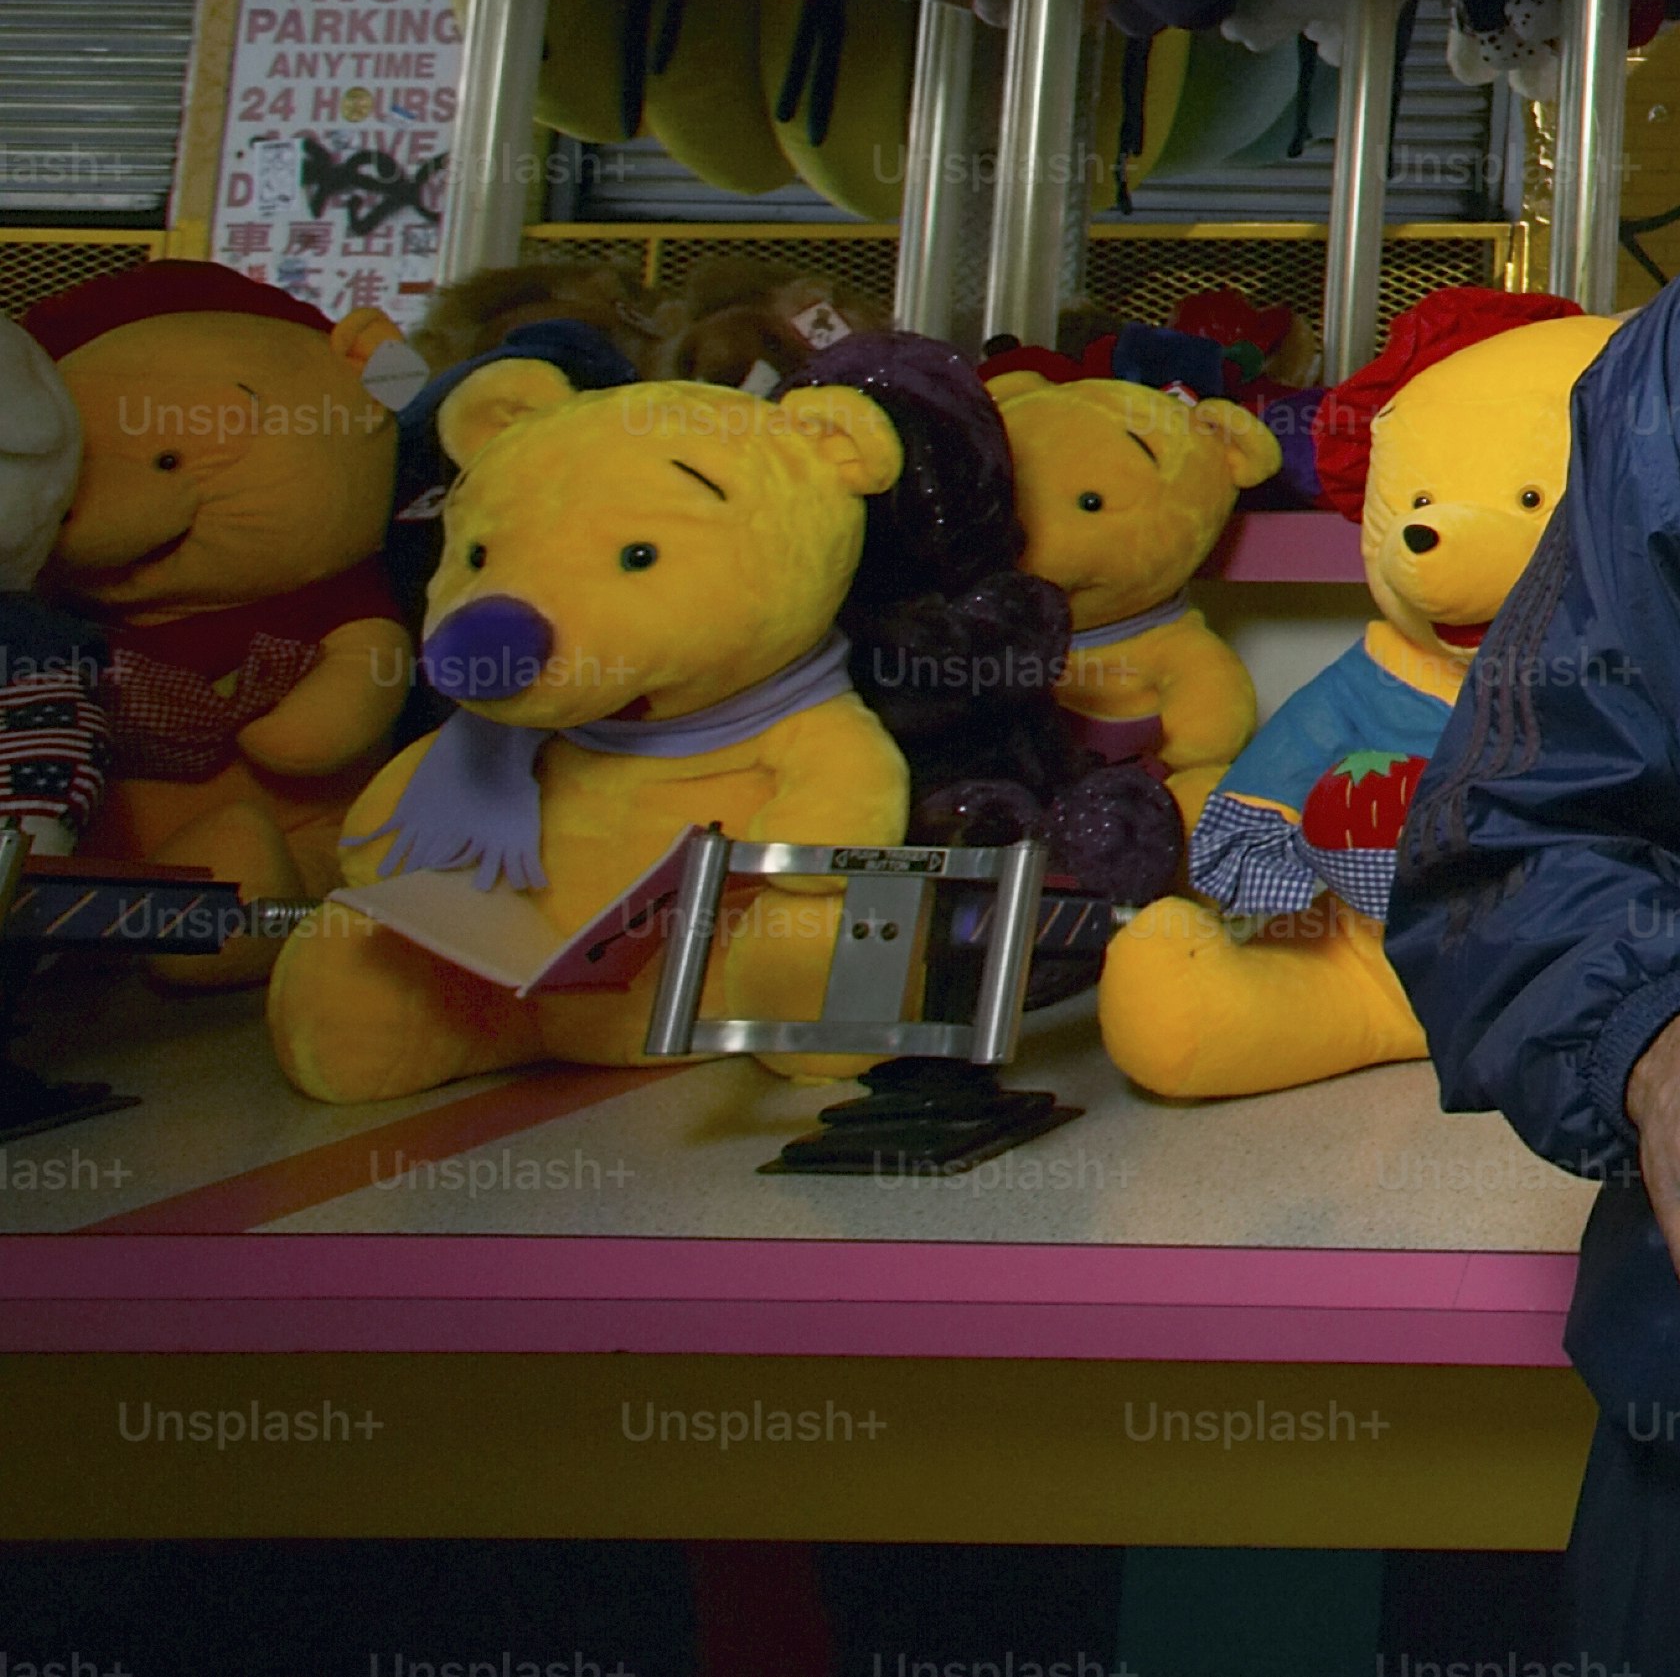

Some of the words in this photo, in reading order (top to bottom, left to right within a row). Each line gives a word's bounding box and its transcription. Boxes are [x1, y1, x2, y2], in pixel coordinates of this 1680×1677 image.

[245, 8, 464, 45] PARKING
[266, 52, 436, 80] ANYTIME
[238, 86, 296, 124] 24
[311, 86, 458, 124] HURS
